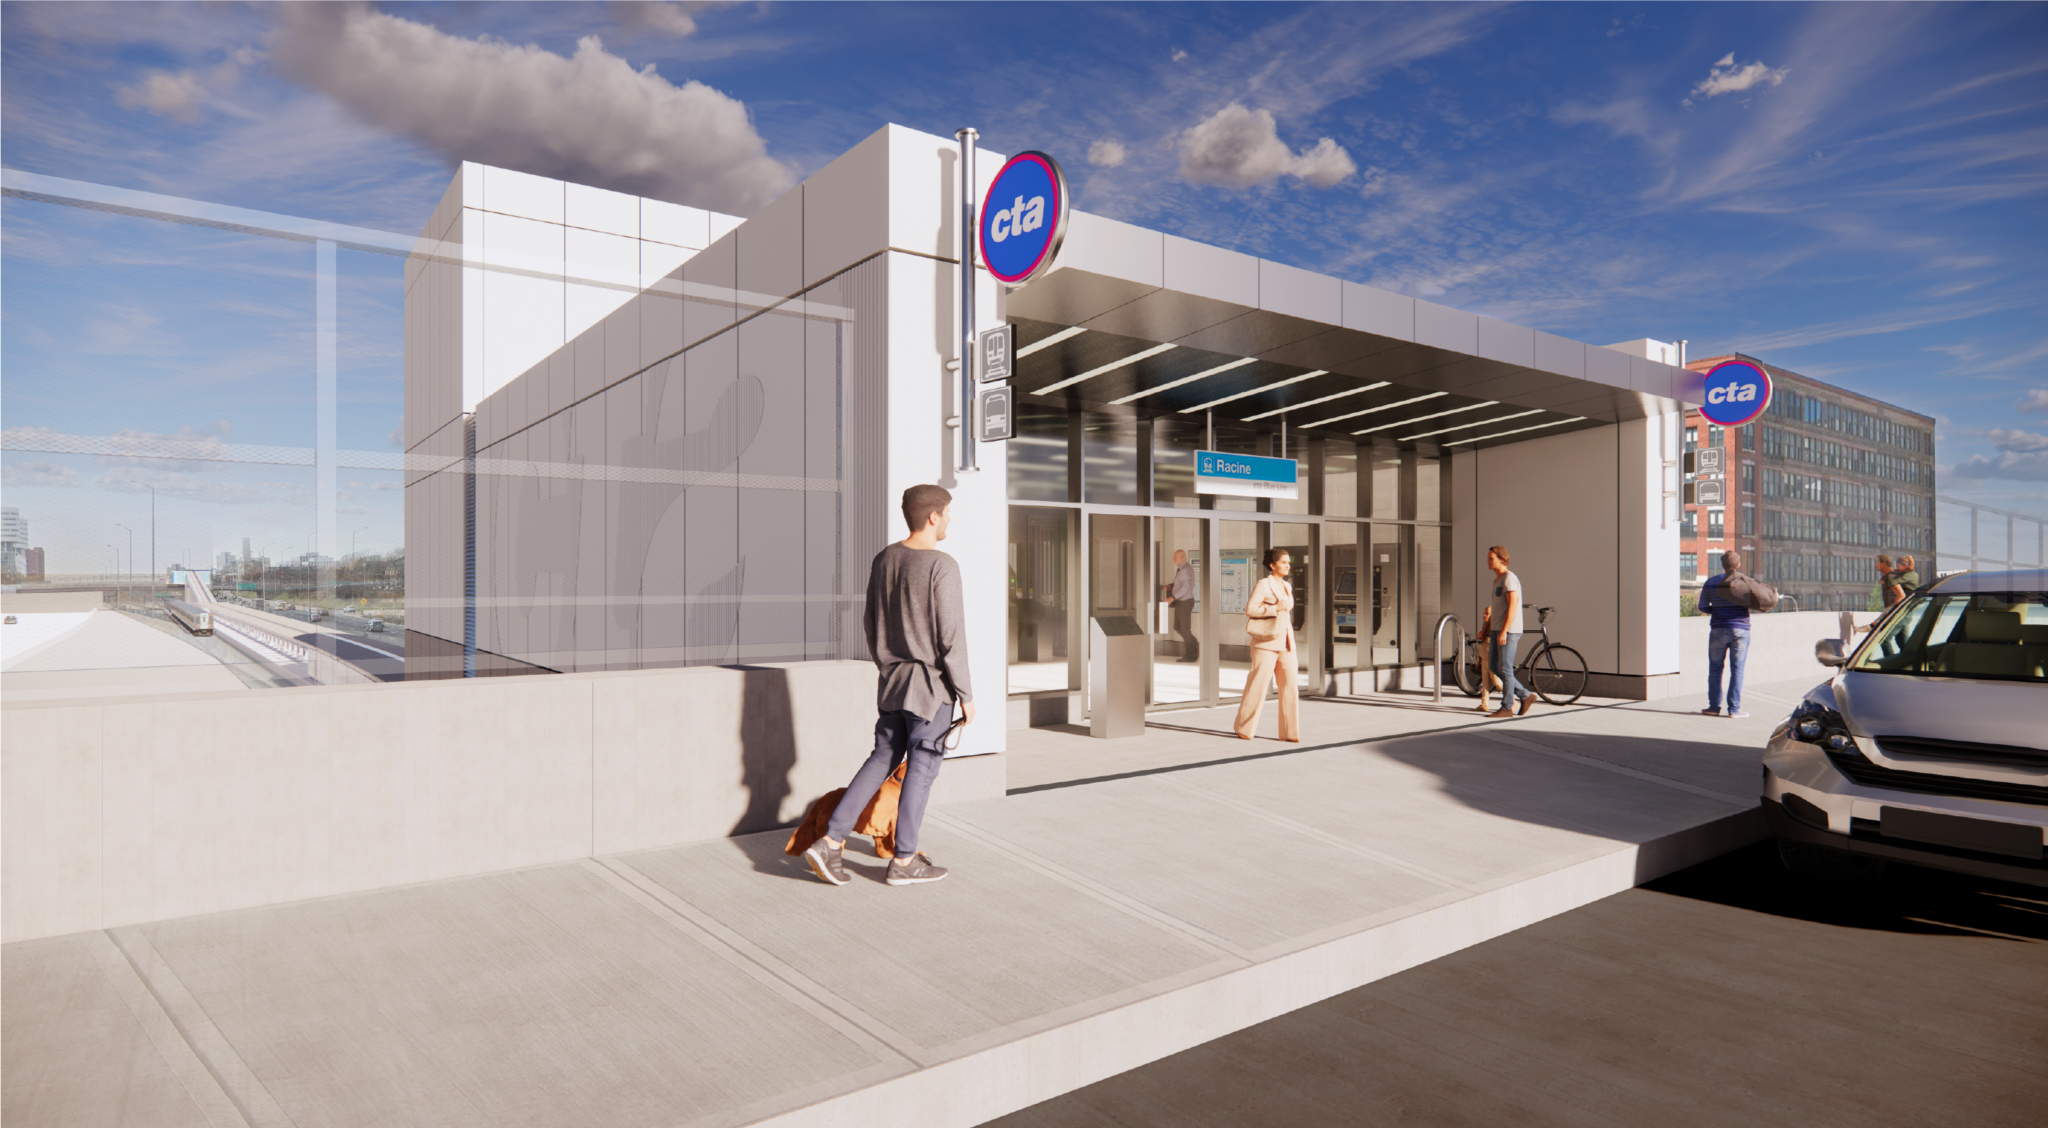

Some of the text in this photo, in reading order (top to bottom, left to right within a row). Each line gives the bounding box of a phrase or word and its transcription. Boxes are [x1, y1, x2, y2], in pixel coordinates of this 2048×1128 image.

[991, 195, 1045, 243] cta
[1707, 381, 1757, 405] cta
[1216, 459, 1252, 475] Racine
